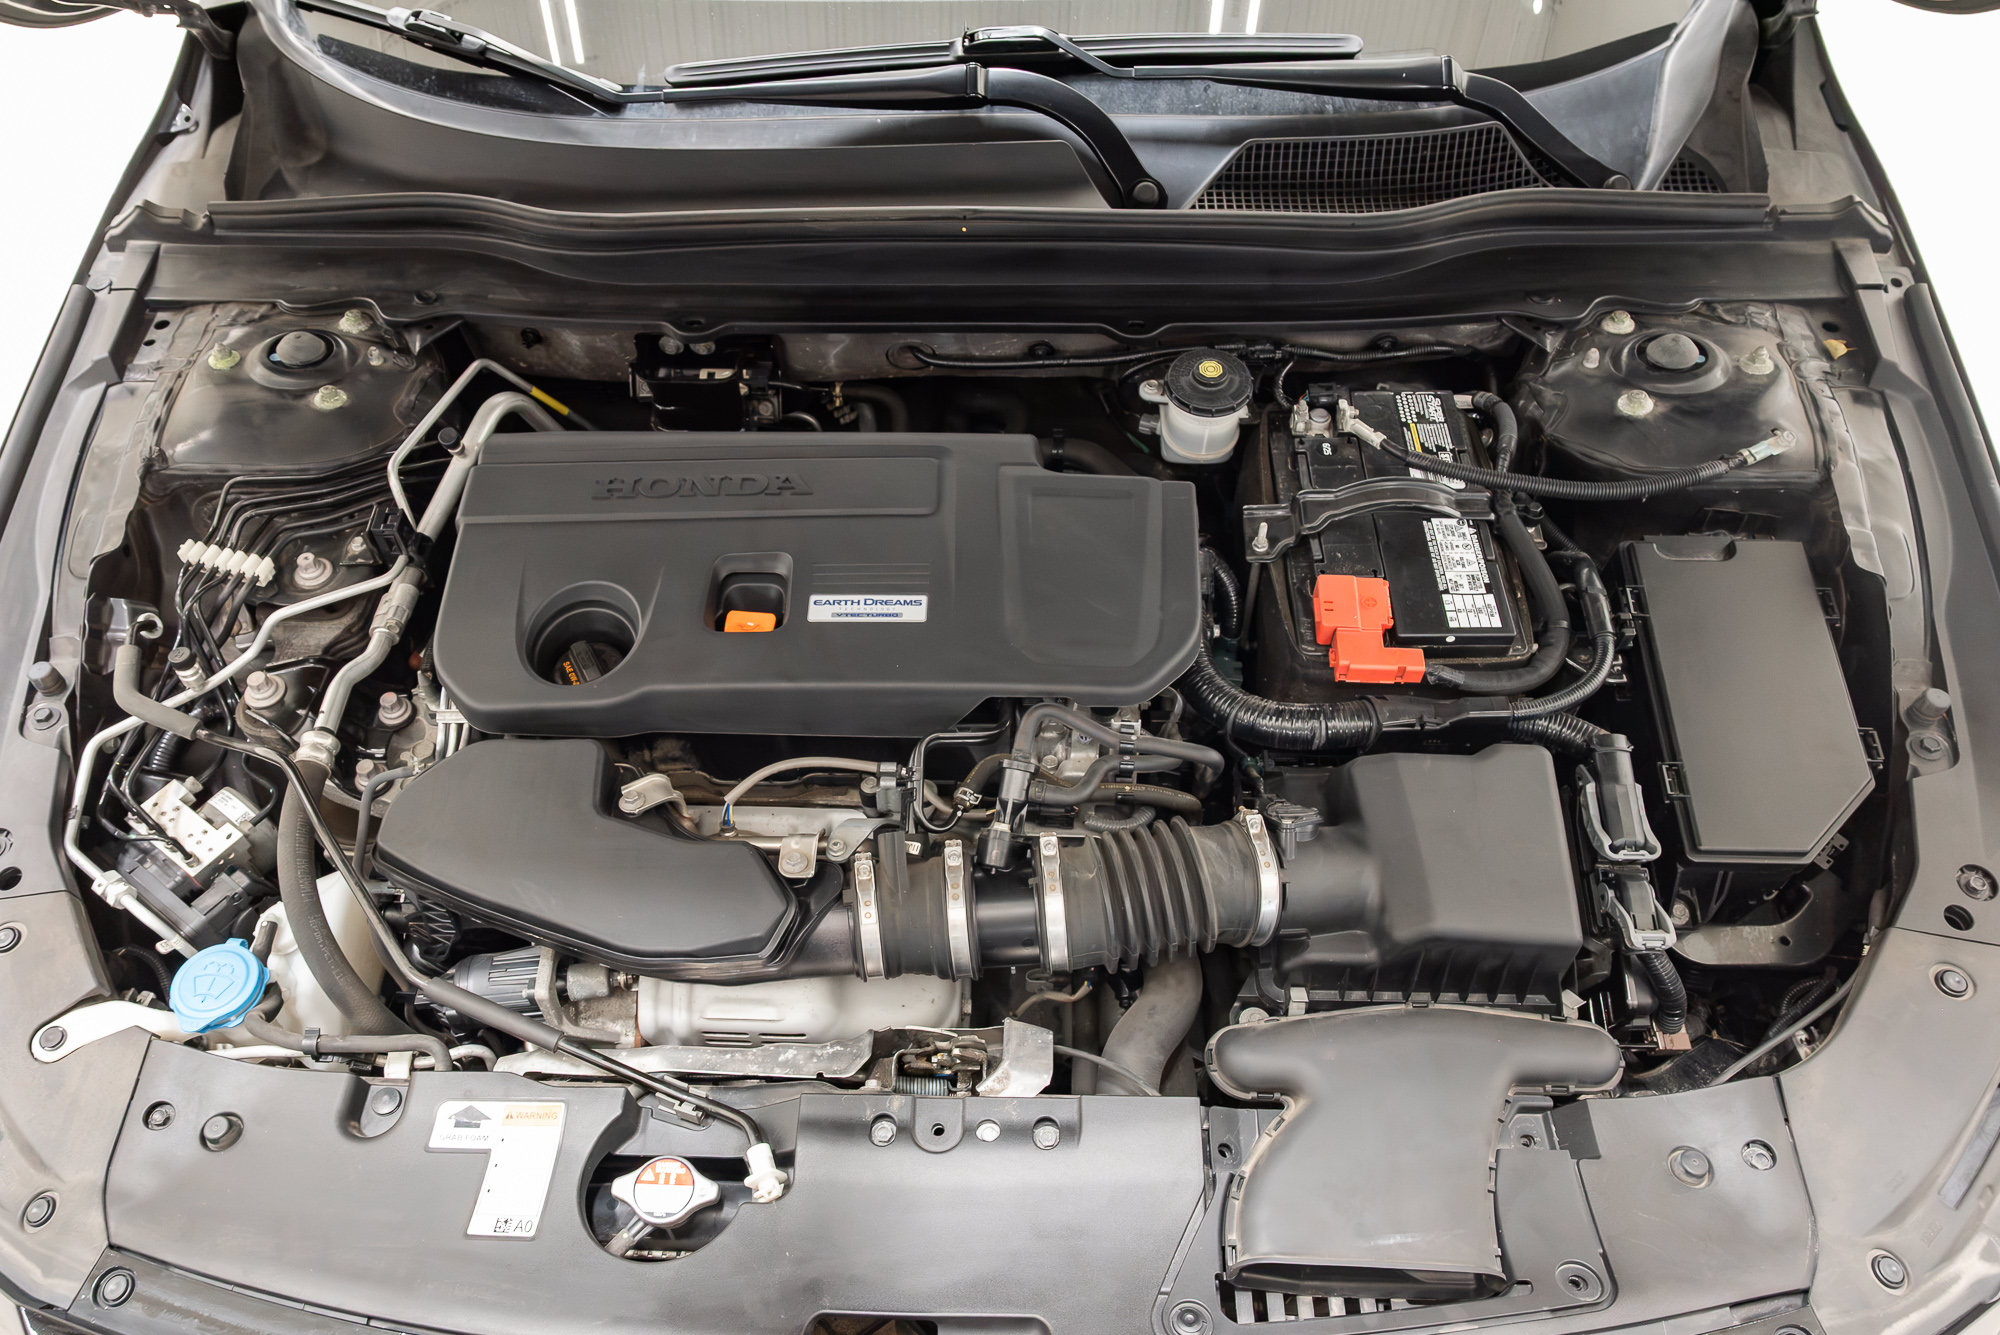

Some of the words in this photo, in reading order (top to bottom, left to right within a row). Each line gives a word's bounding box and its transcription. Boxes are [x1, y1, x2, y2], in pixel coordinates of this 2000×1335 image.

[1426, 395, 1439, 423] START
[1436, 397, 1445, 422] SUPER
[591, 473, 814, 500] HONDA
[863, 598, 923, 607] DREAMS
[563, 661, 574, 674] SAE
[568, 672, 580, 686] 0W-2
[515, 1111, 558, 1120] WARNING
